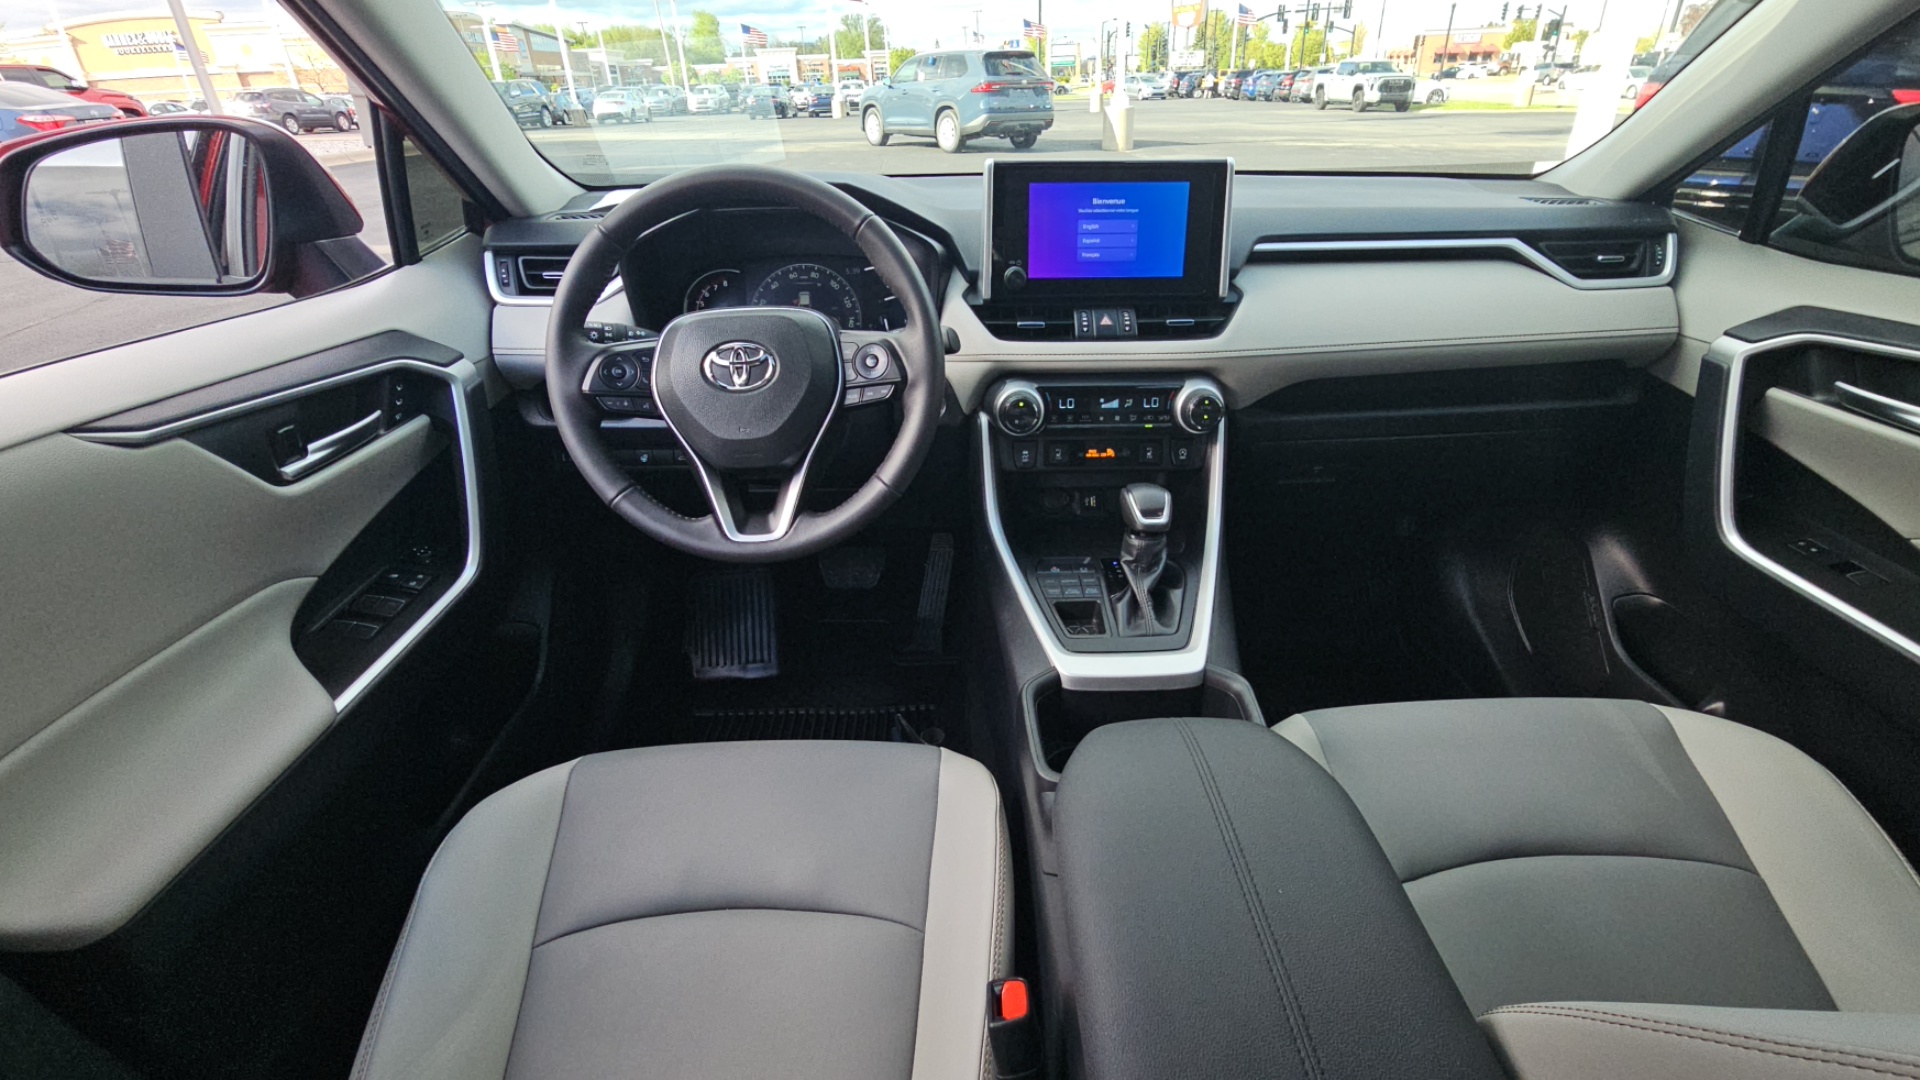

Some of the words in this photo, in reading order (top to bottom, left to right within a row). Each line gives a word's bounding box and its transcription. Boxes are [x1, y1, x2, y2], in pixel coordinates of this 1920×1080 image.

[809, 271, 820, 279] 80
[712, 284, 718, 292] 7
[770, 281, 780, 290] 40
[829, 279, 840, 290] 100
[843, 296, 852, 309] 120
[1059, 398, 1075, 409] LO
[1143, 397, 1159, 408] LO
